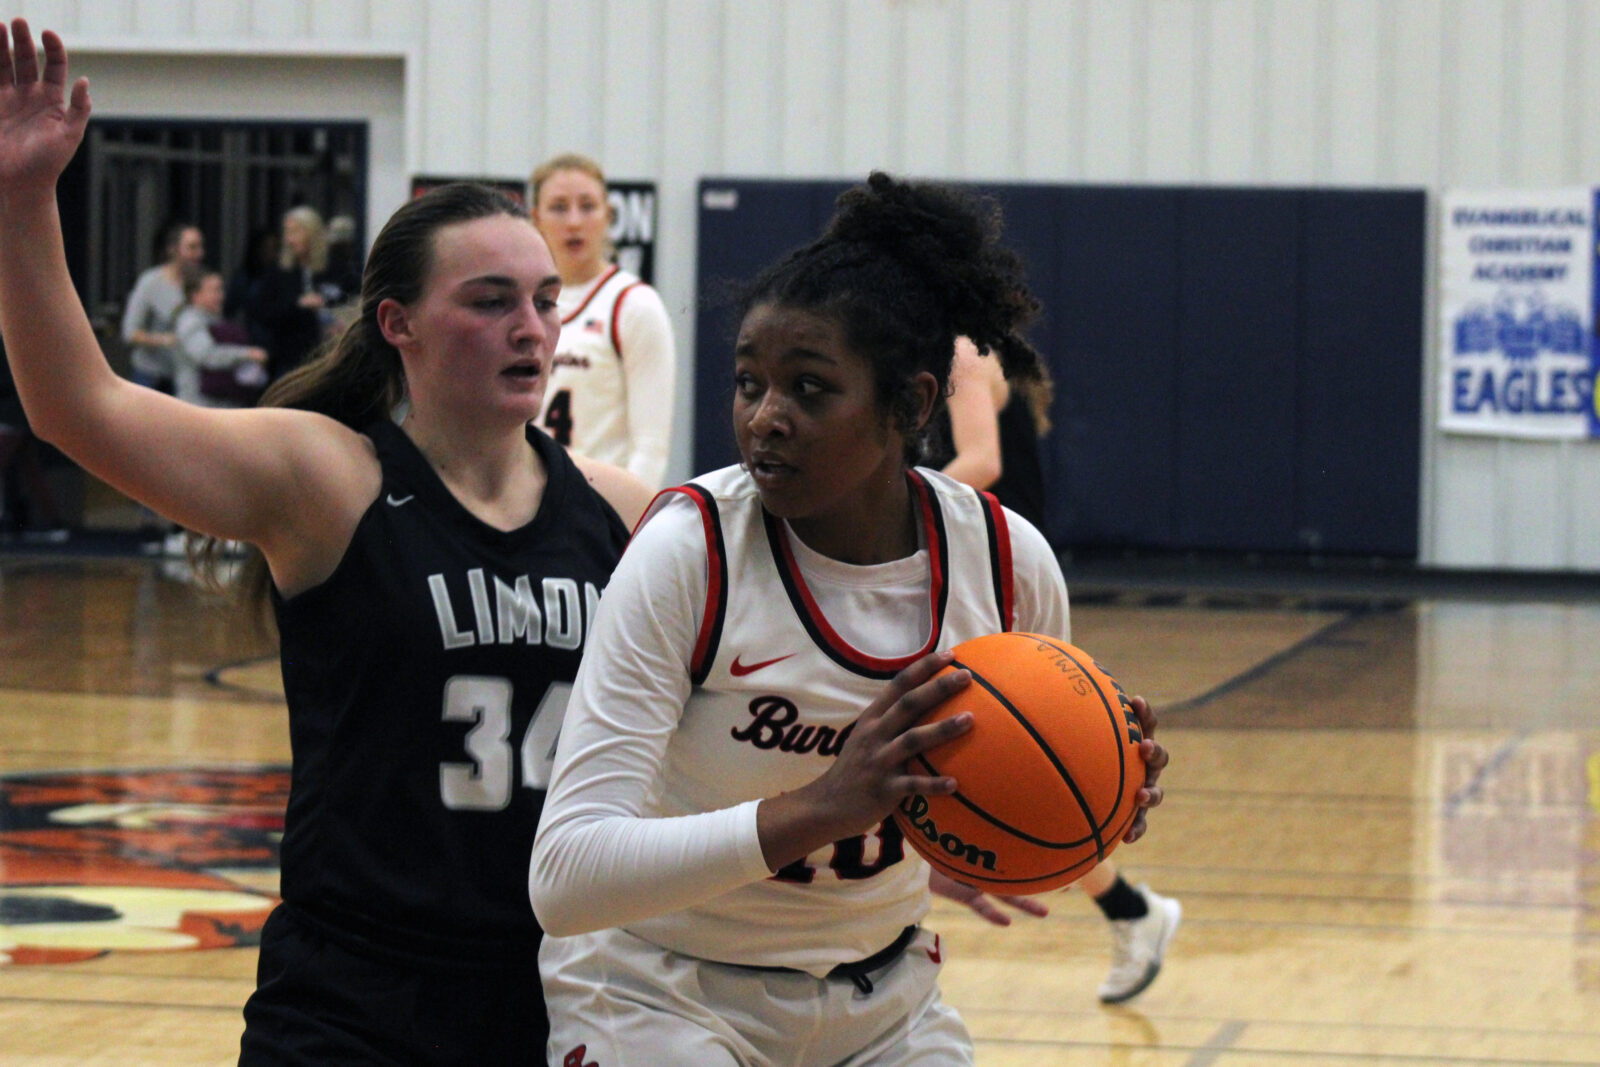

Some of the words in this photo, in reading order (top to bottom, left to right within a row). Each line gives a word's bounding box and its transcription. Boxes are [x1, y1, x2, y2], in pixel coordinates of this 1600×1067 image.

[1453, 207, 1586, 226] EVANGELICAL
[1469, 237, 1571, 254] CHRISTIAN
[1474, 264, 1567, 281] ACADEMY
[1453, 368, 1589, 414] EAGLES
[900, 794, 997, 872] lson
